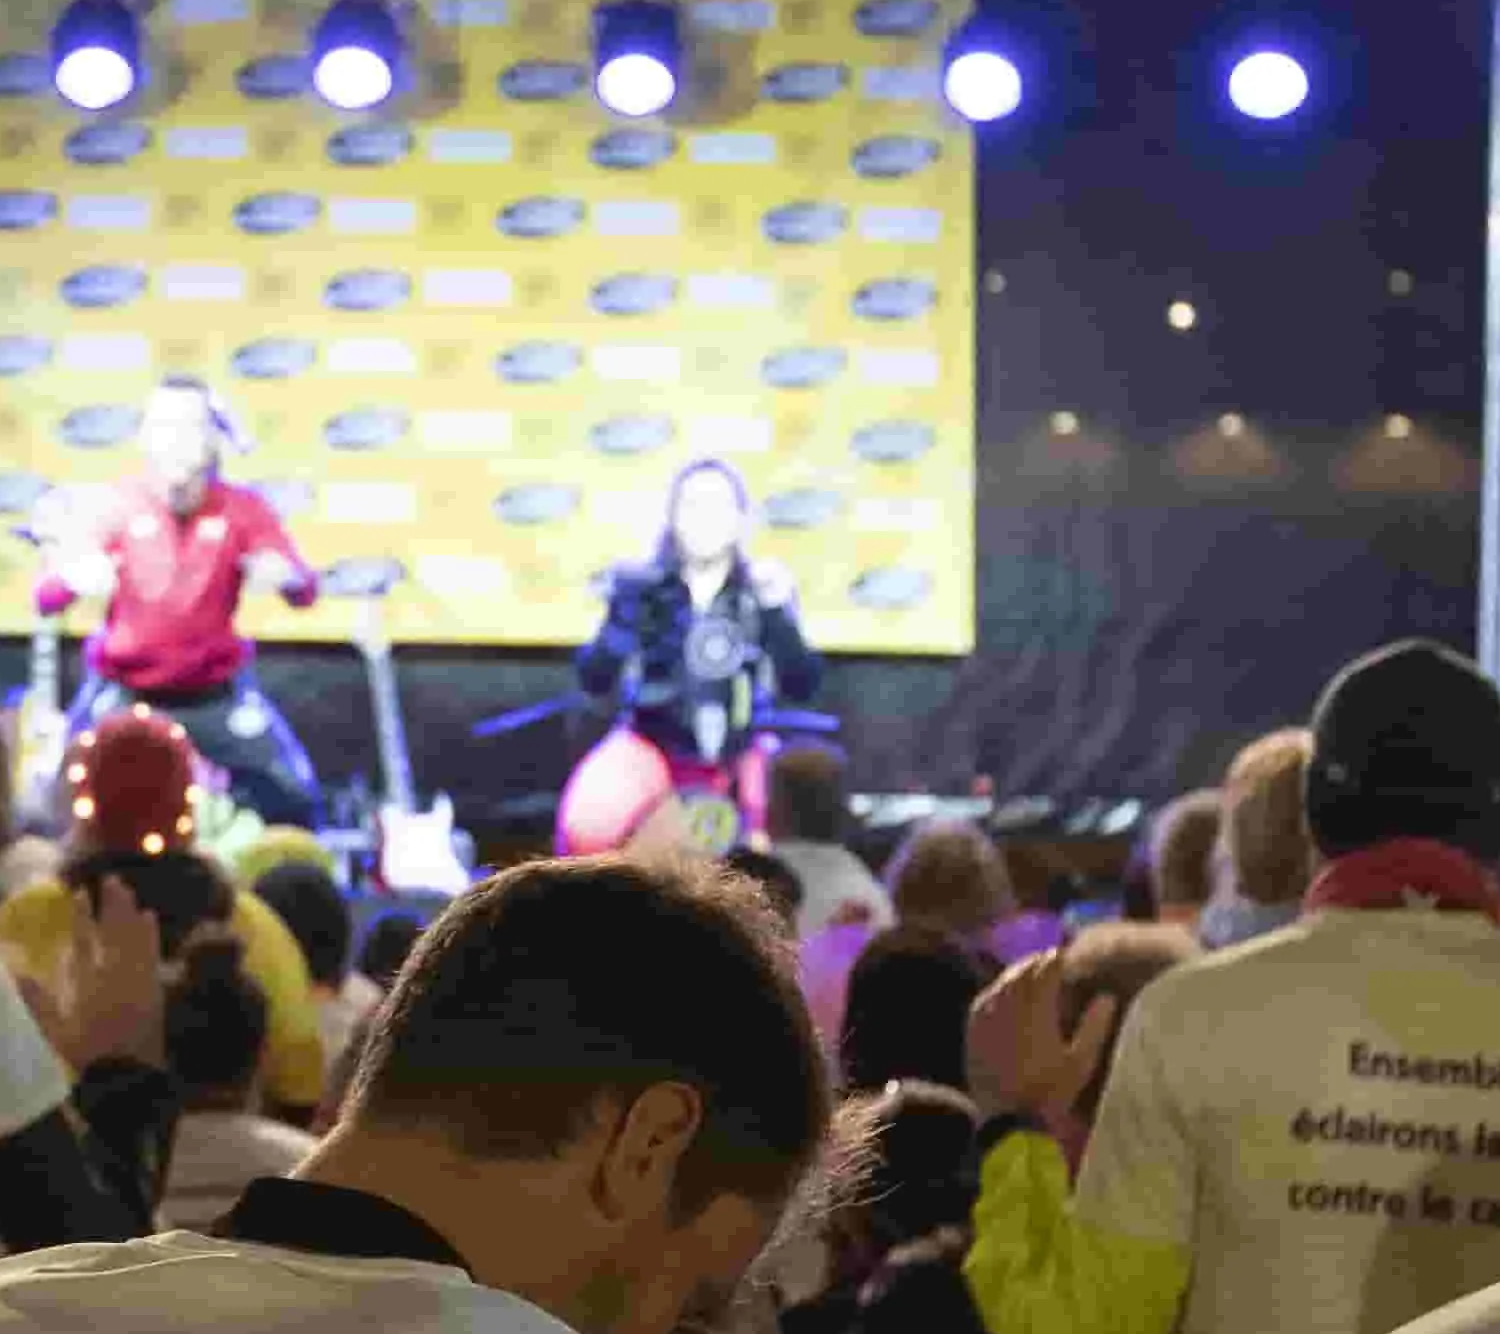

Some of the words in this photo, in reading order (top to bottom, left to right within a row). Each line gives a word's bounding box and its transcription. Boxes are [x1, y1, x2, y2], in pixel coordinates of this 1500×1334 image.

[1290, 1106, 1462, 1157] éclairons
[1287, 1178, 1408, 1218] contre
[1420, 1182, 1455, 1222] le
